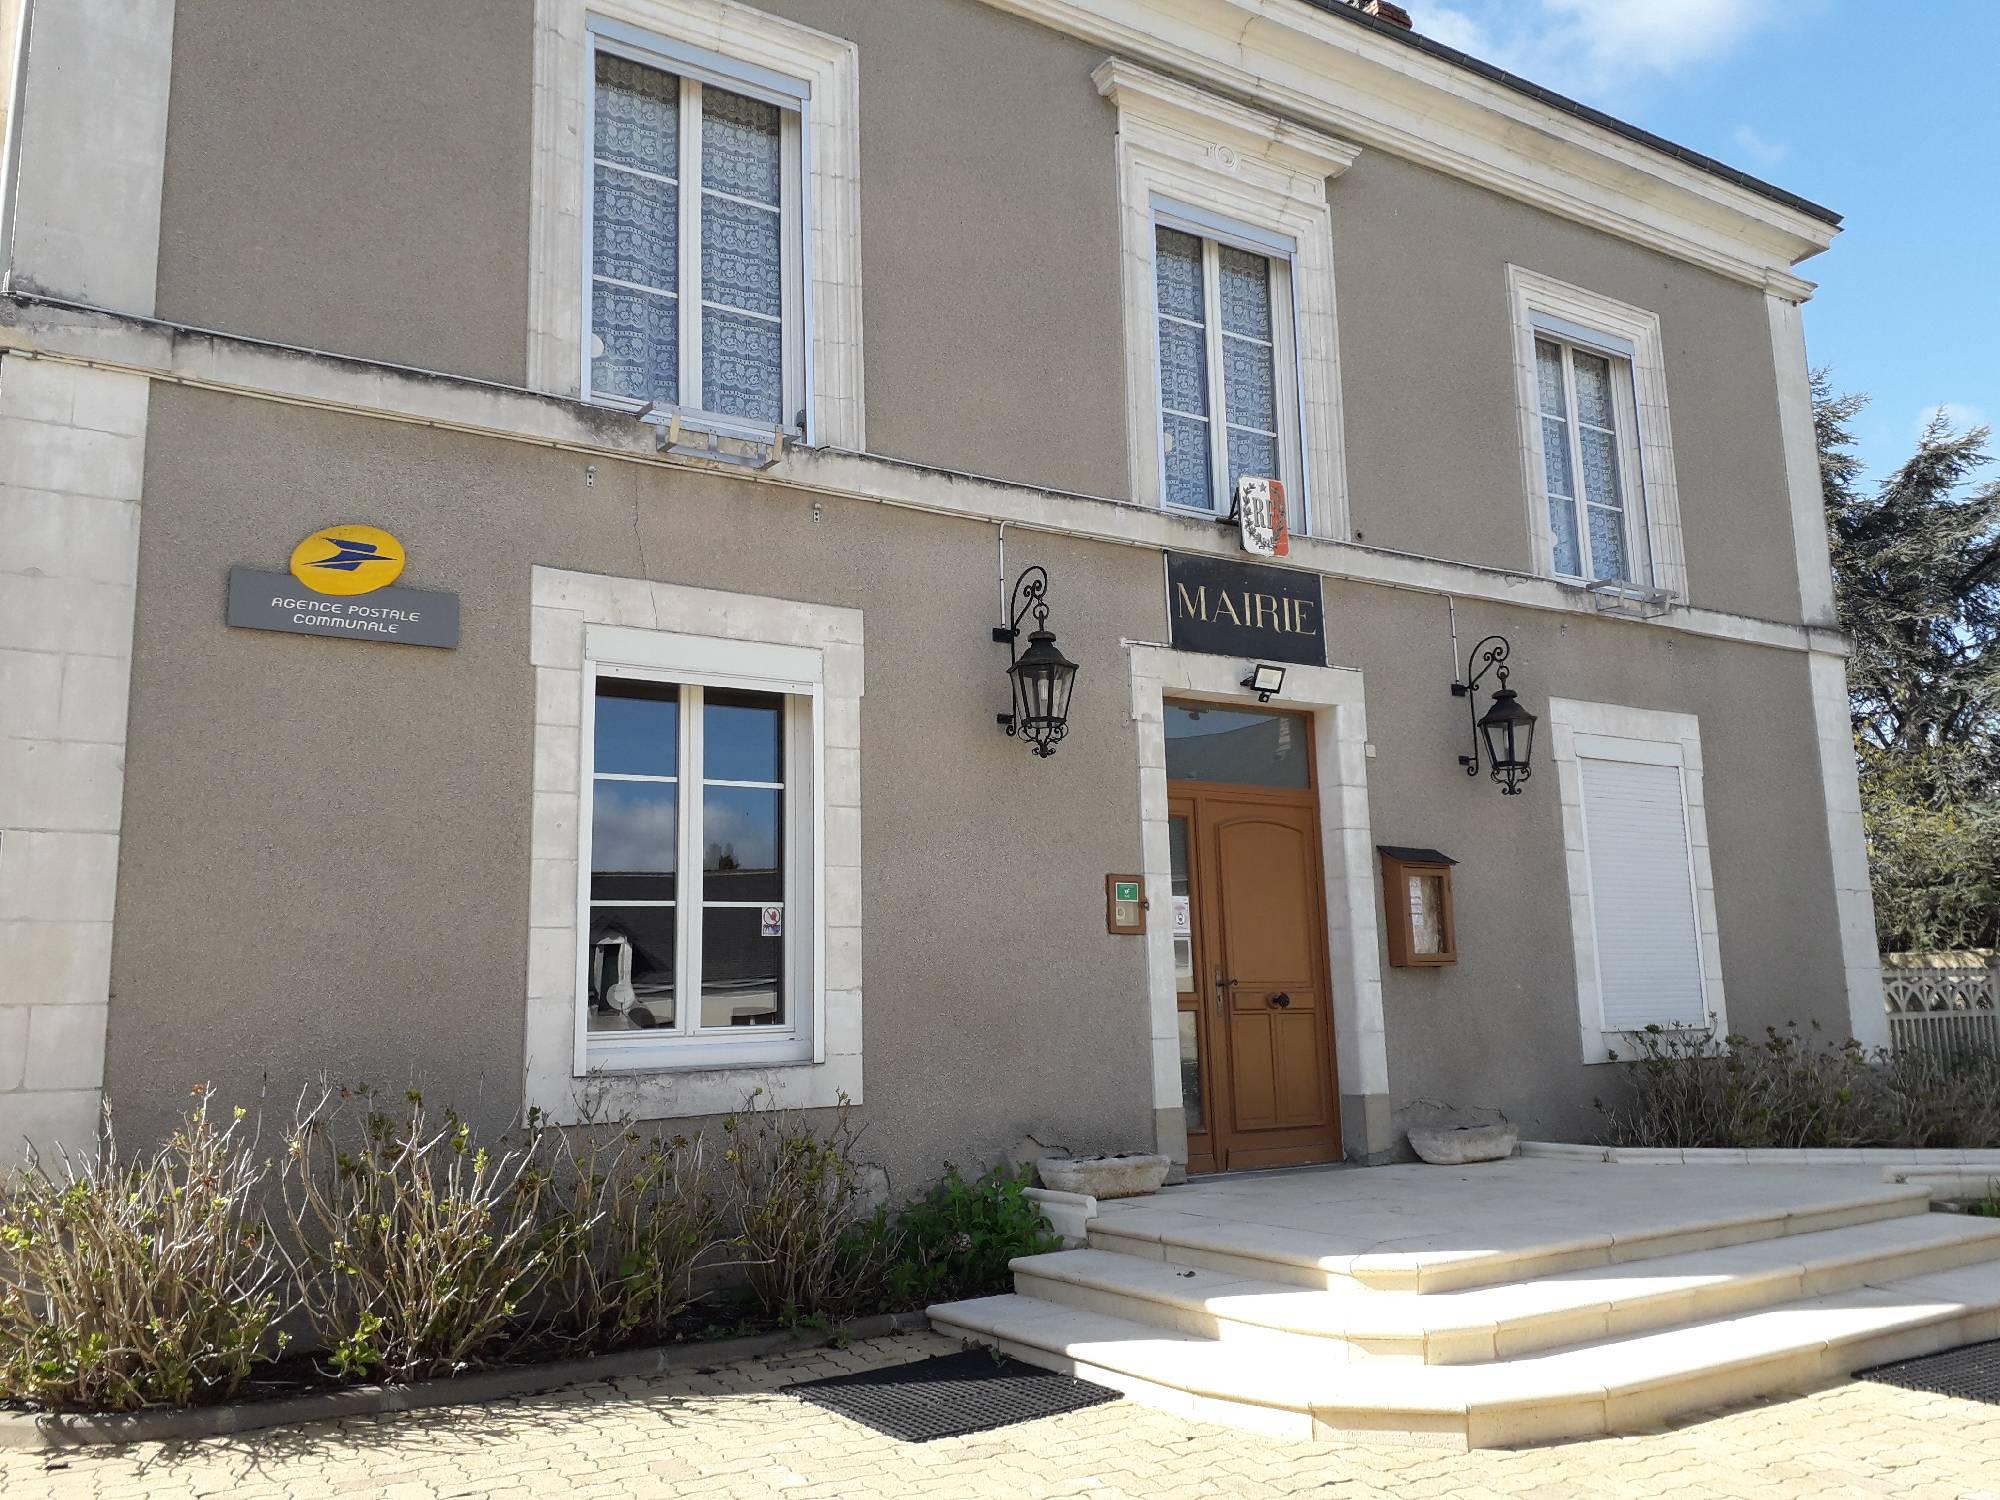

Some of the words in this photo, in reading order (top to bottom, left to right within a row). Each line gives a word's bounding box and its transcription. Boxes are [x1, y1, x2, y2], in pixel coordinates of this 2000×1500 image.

[271, 597, 343, 614] AGENCE
[348, 605, 421, 622] POSTALE
[1176, 582, 1316, 635] MAIRIE
[293, 613, 399, 634] COMMUNALE
